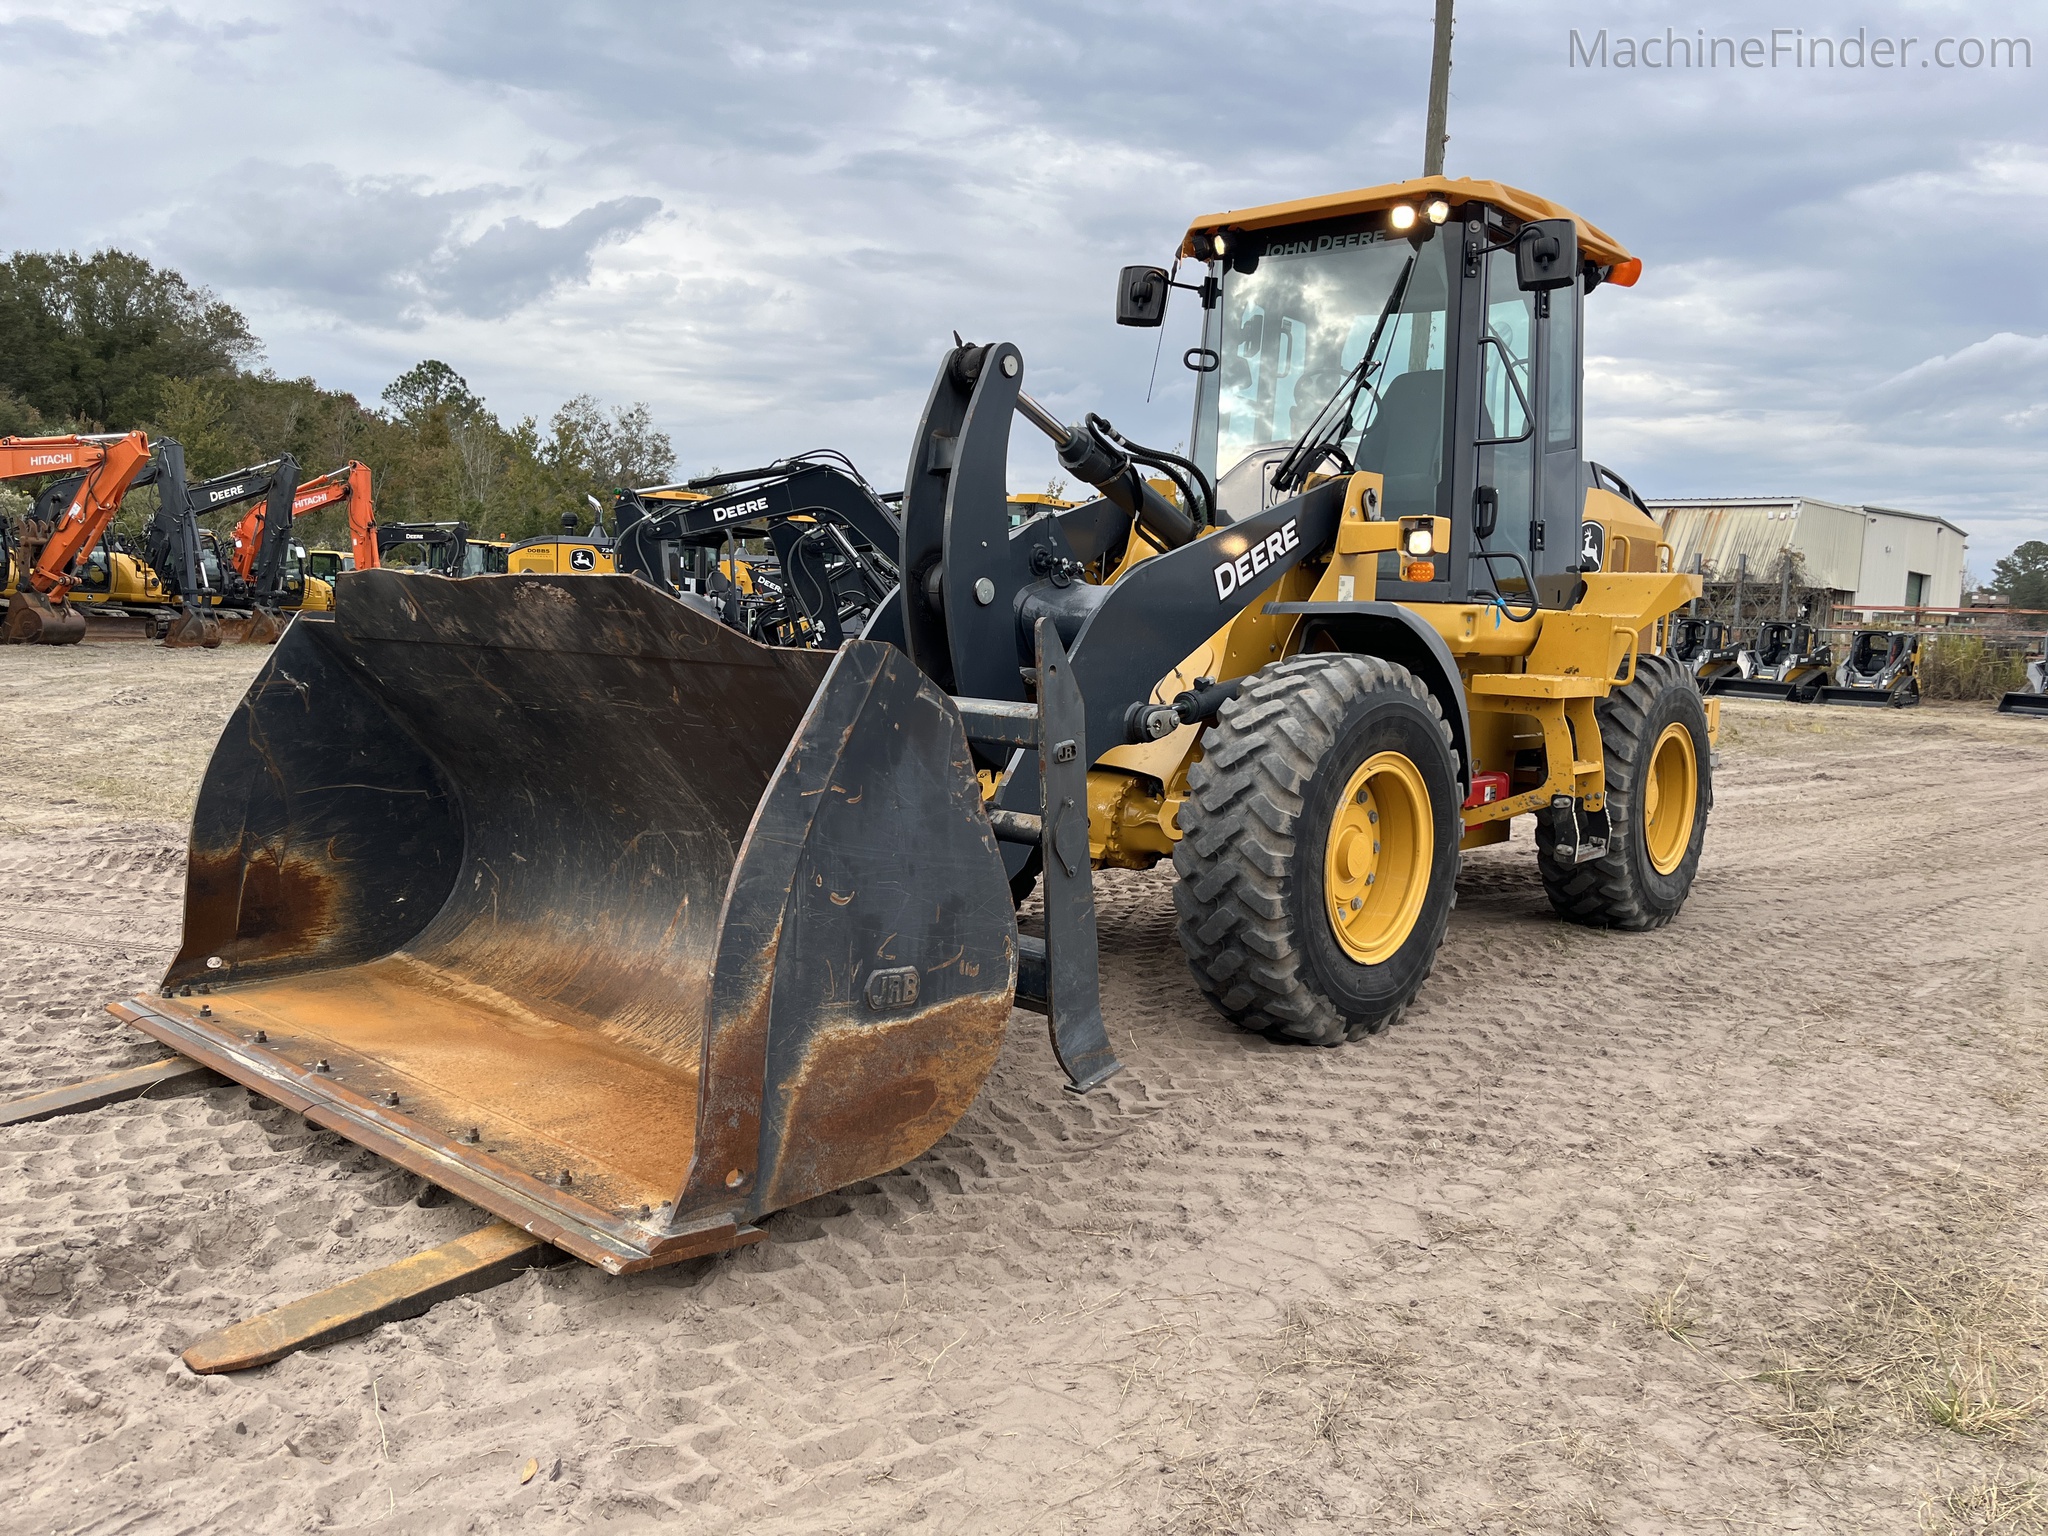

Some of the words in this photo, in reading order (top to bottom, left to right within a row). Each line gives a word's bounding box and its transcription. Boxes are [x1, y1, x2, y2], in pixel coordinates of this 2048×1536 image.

[1264, 240, 1313, 256] JOHN
[1316, 229, 1387, 251] DEERE
[30, 453, 73, 466] HITACHI
[209, 484, 245, 503] DEERE
[295, 493, 327, 508] HITACHI
[712, 497, 769, 522] DEERE
[1213, 518, 1300, 601] DEERE
[757, 575, 783, 594] DEER
[872, 973, 918, 1006] JRB
